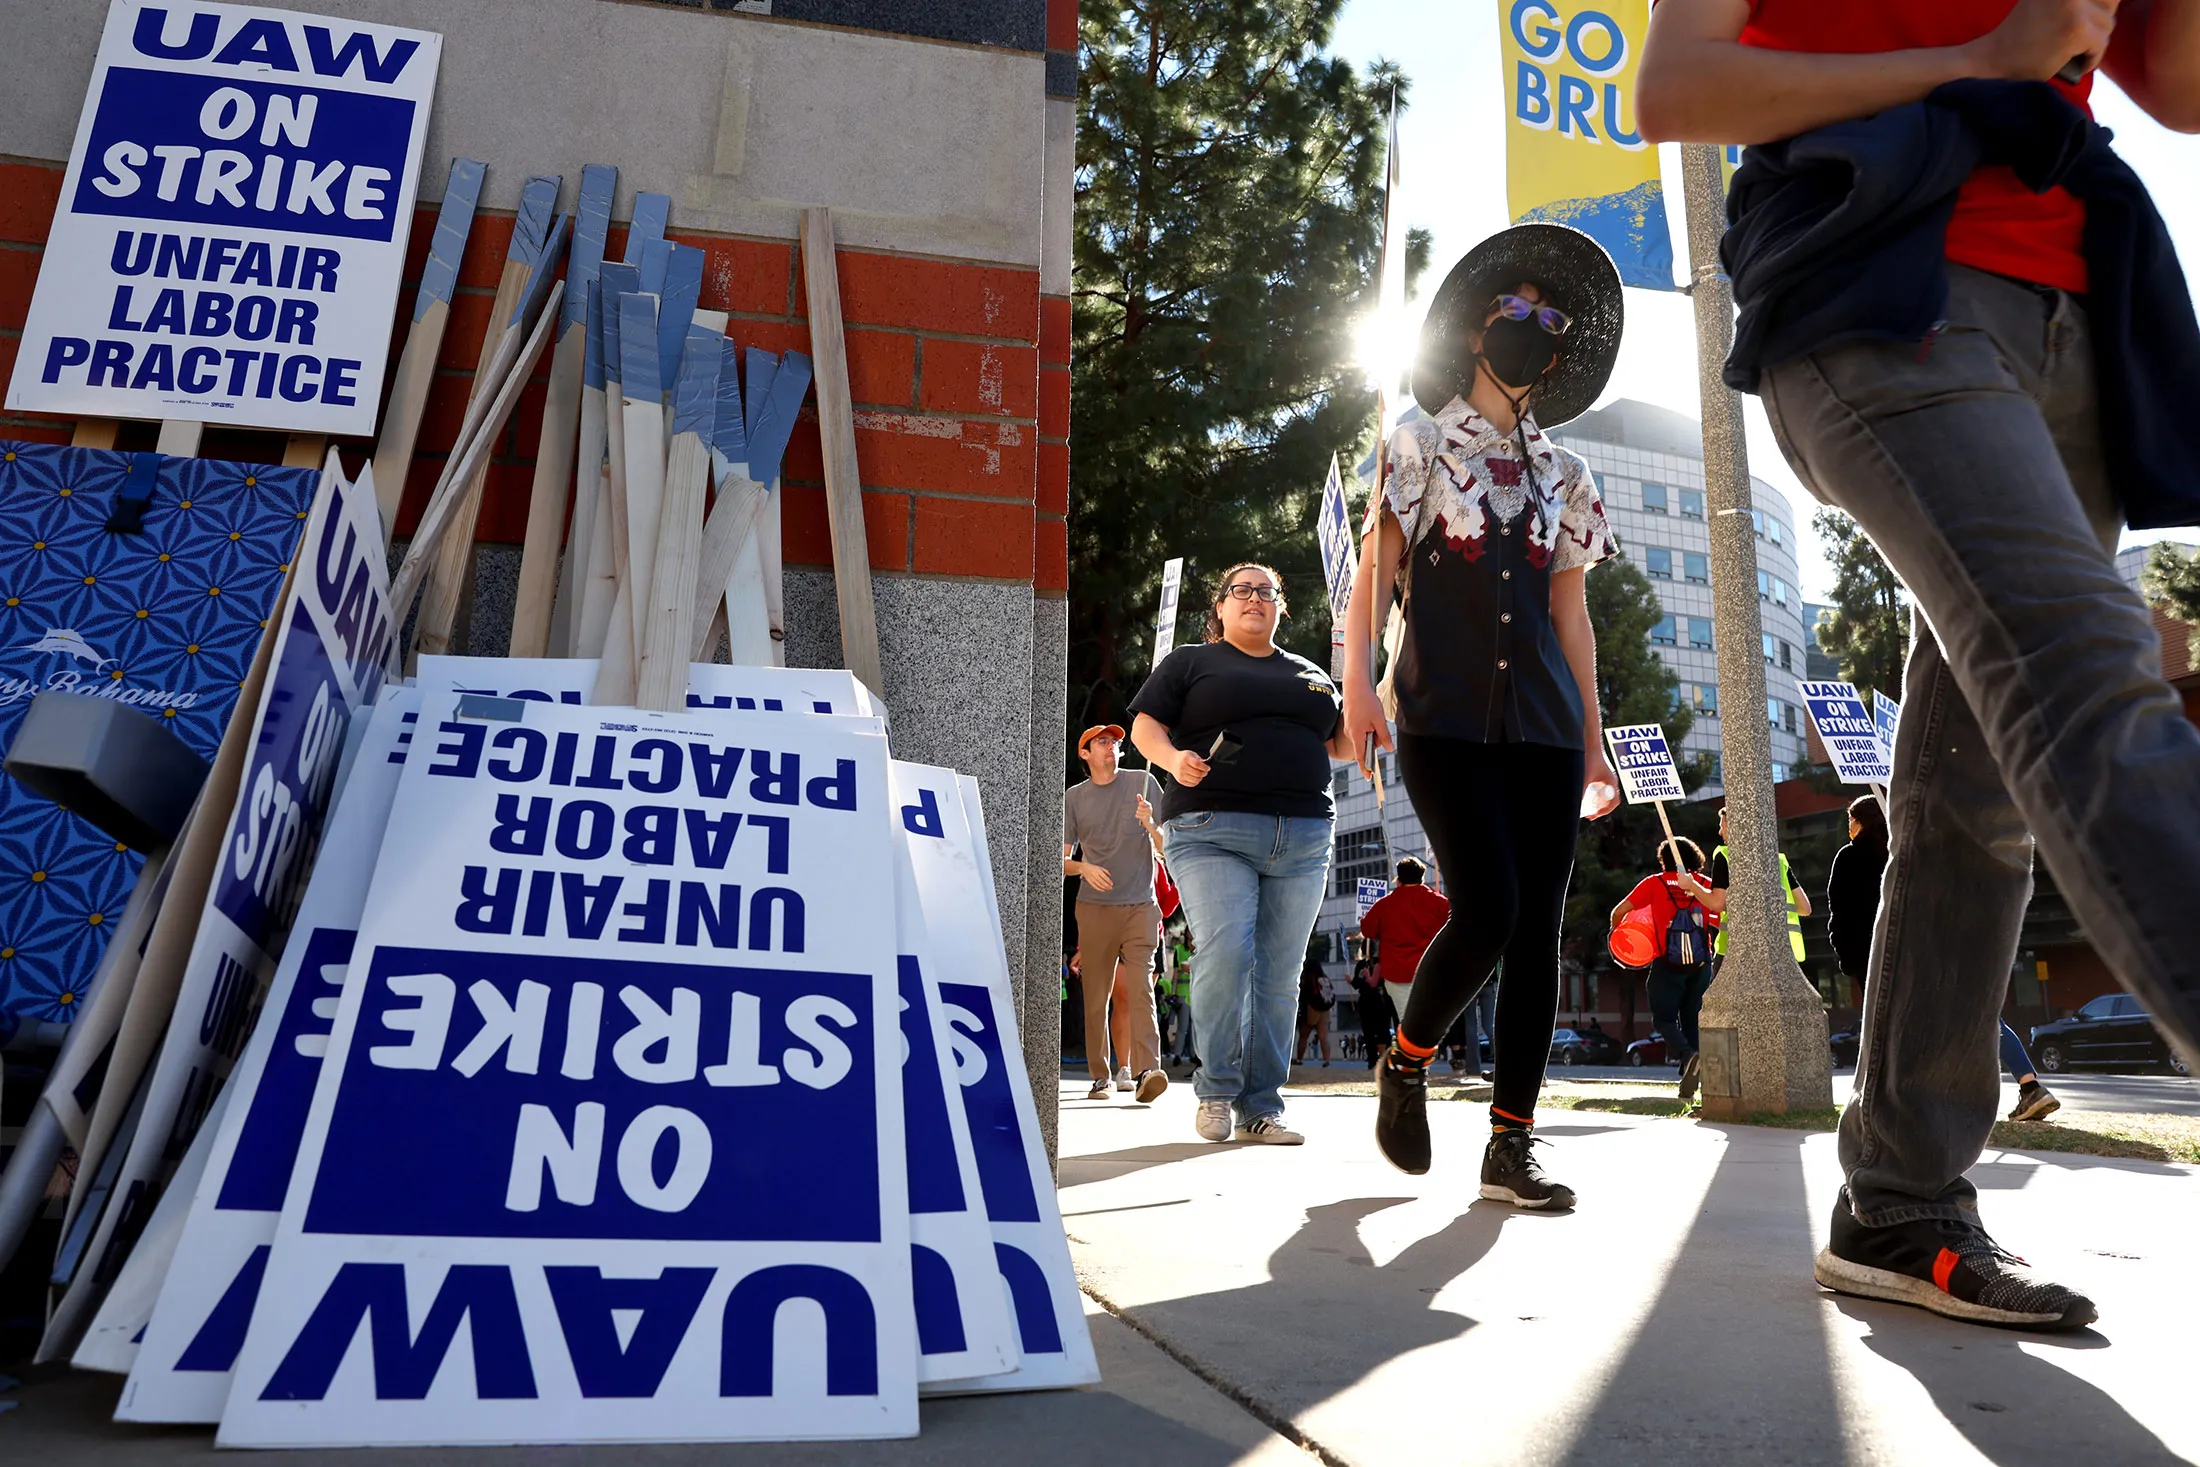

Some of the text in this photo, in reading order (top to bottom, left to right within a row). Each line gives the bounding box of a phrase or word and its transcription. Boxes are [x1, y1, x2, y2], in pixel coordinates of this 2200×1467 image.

[133, 8, 420, 84] UAW
[1510, 0, 1627, 75] GO
[200, 87, 318, 148] ON
[92, 141, 391, 220] STRIKE
[110, 231, 341, 293] UNFAIR
[108, 285, 320, 345] LABOR
[41, 336, 362, 407] PRACTICE
[317, 484, 392, 705] UAW
[1802, 684, 1853, 697] UAW
[1827, 702, 1850, 716] ON
[1877, 693, 1899, 716] UA
[298, 680, 343, 811] ON
[1611, 727, 1658, 740] UAW
[1819, 718, 1872, 733] STRIKE
[1834, 740, 1875, 751] UNFAIR
[428, 721, 857, 811] PRACTICE
[1620, 752, 1669, 766] STRIKE
[1630, 741, 1651, 753] ON
[1842, 752, 1879, 763] LABOR
[1630, 768, 1668, 779] UNFAIR
[1630, 786, 1680, 798] PRACTICE
[1636, 778, 1669, 788] LABOR
[489, 793, 790, 874] LABOR
[1359, 895, 1376, 903] STRI
[1360, 879, 1385, 888] UAW
[1366, 888, 1378, 896] ON
[454, 865, 805, 953] UNFAIR
[369, 973, 858, 1090] STRIKE
[505, 1101, 713, 1212] ON
[257, 1262, 878, 1400] UAW
